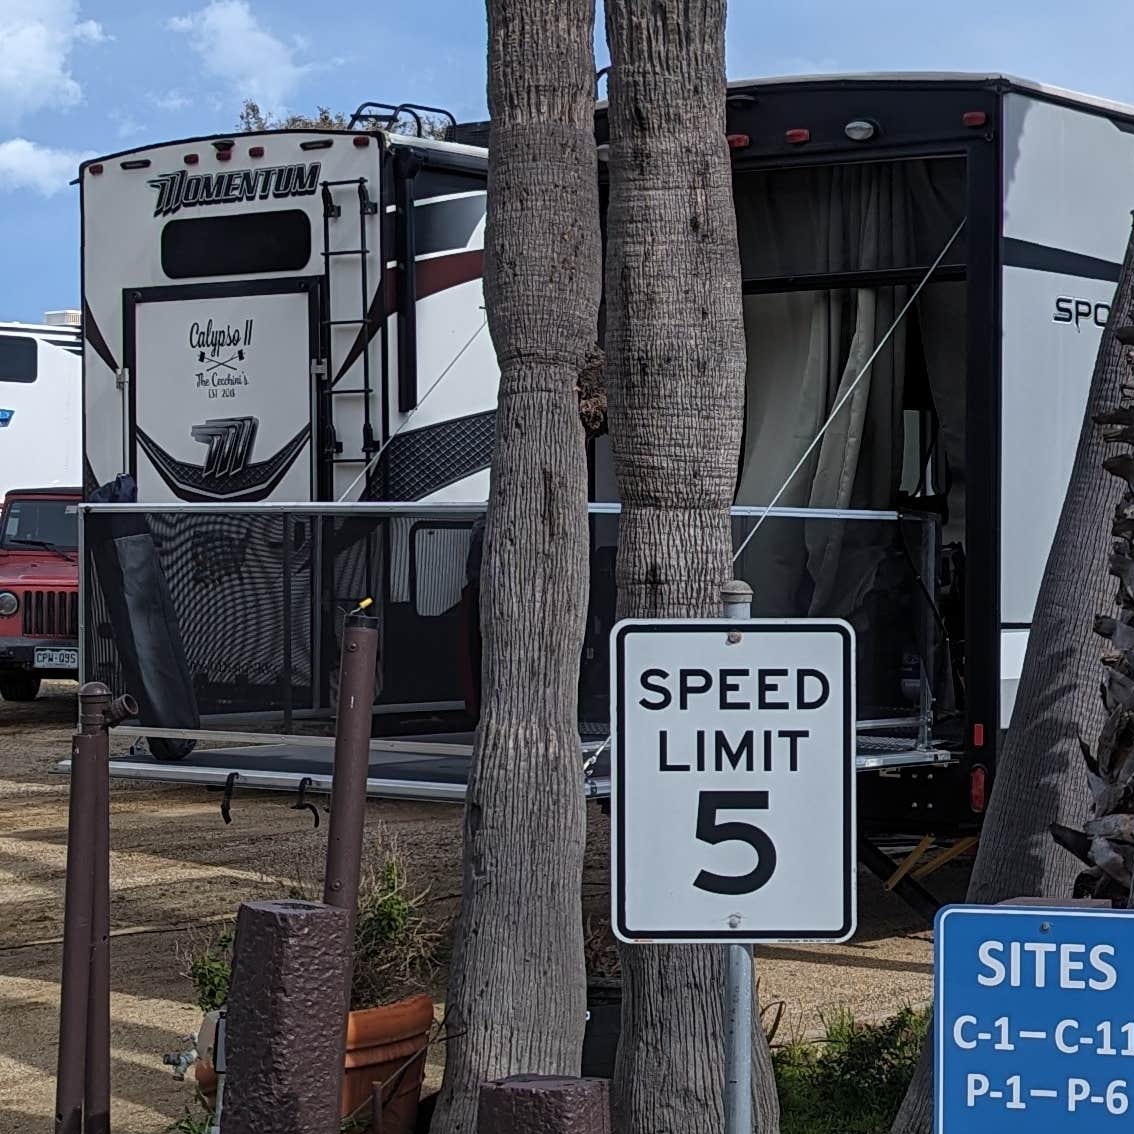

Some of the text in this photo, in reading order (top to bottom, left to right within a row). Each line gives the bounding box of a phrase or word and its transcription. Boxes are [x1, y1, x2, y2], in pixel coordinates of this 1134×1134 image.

[147, 162, 321, 217] MOMENTUM
[190, 319, 241, 357] Calypso
[195, 372, 210, 387] The
[638, 668, 830, 711] SPEED
[659, 729, 810, 772] LIMIT
[692, 790, 777, 896] 5
[977, 940, 1117, 991] SITES
